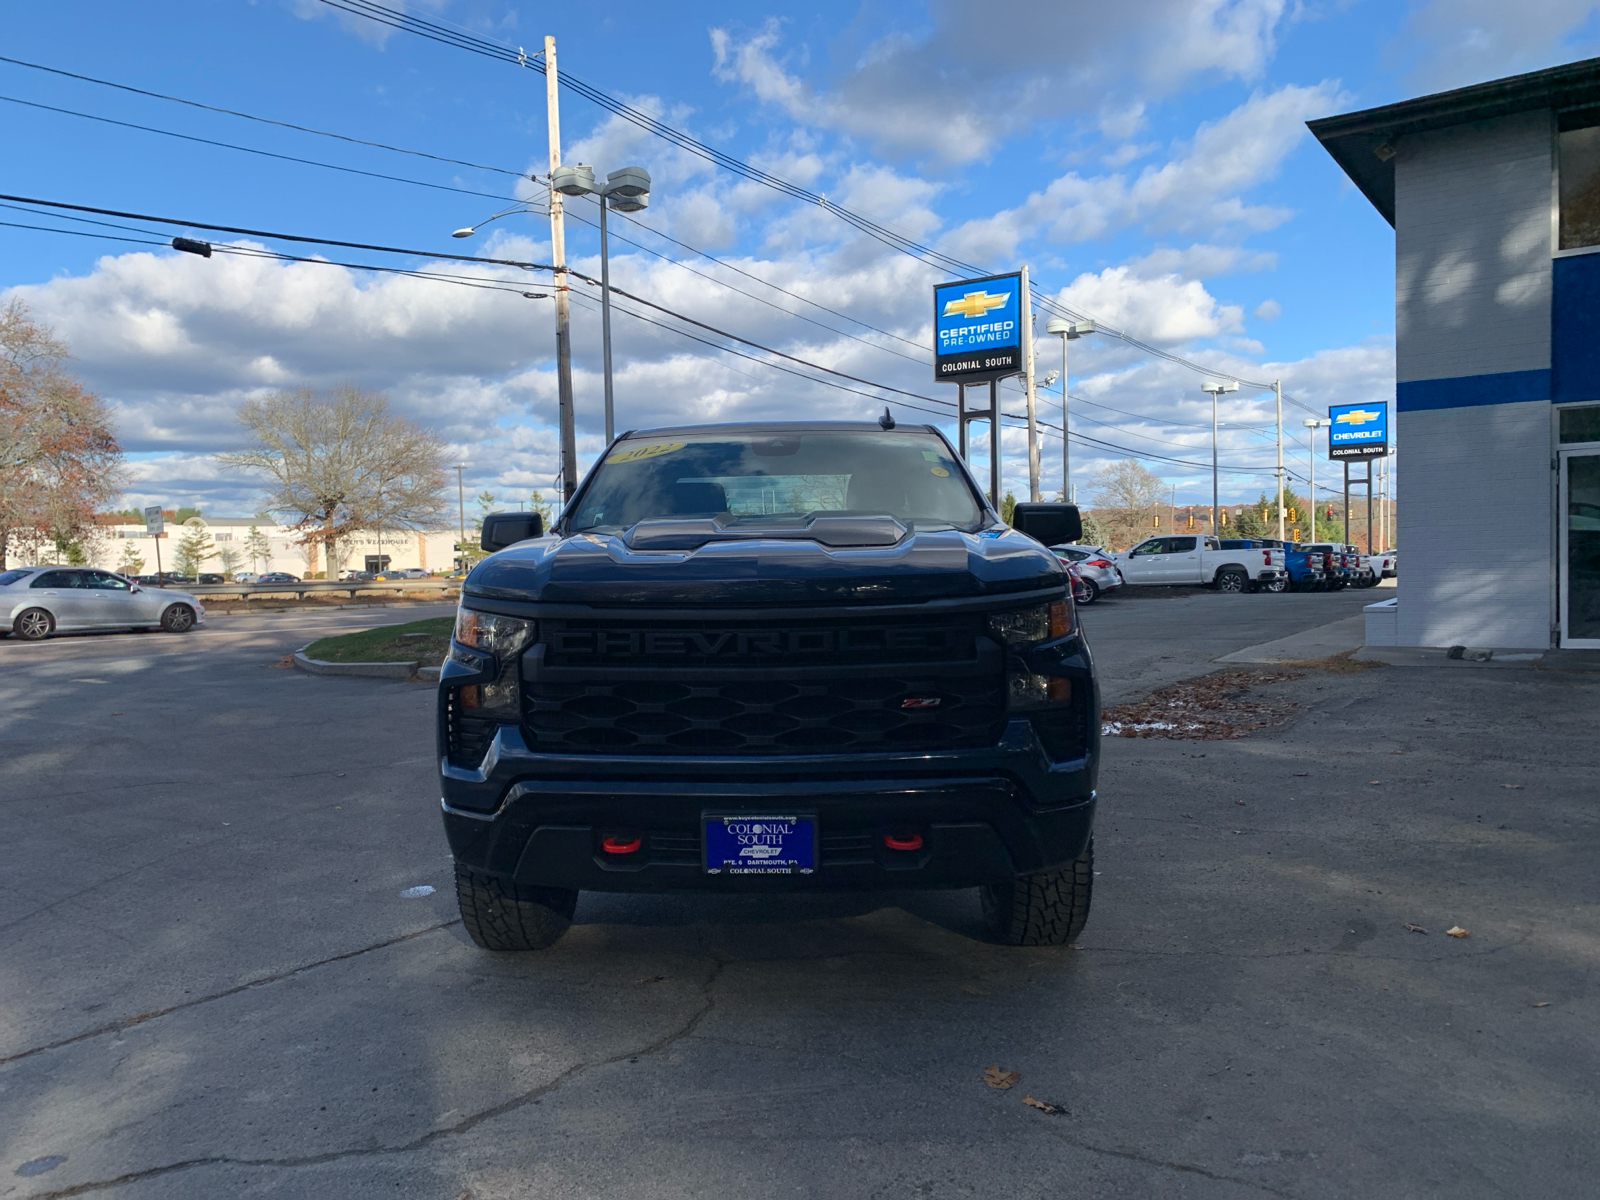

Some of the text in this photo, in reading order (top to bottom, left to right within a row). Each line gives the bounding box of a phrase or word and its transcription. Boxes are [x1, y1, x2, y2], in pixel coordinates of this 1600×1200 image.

[940, 320, 1014, 339] CERTIFIED
[943, 331, 1010, 347] PRE-OWNED
[942, 356, 1012, 372] COLONIAL SOUTH
[1333, 430, 1383, 440] CHEVROLET
[619, 443, 674, 462] 2022
[553, 626, 966, 654] CHEVROLET
[727, 824, 793, 835] COLONIAL
[737, 834, 783, 845] SOUTH
